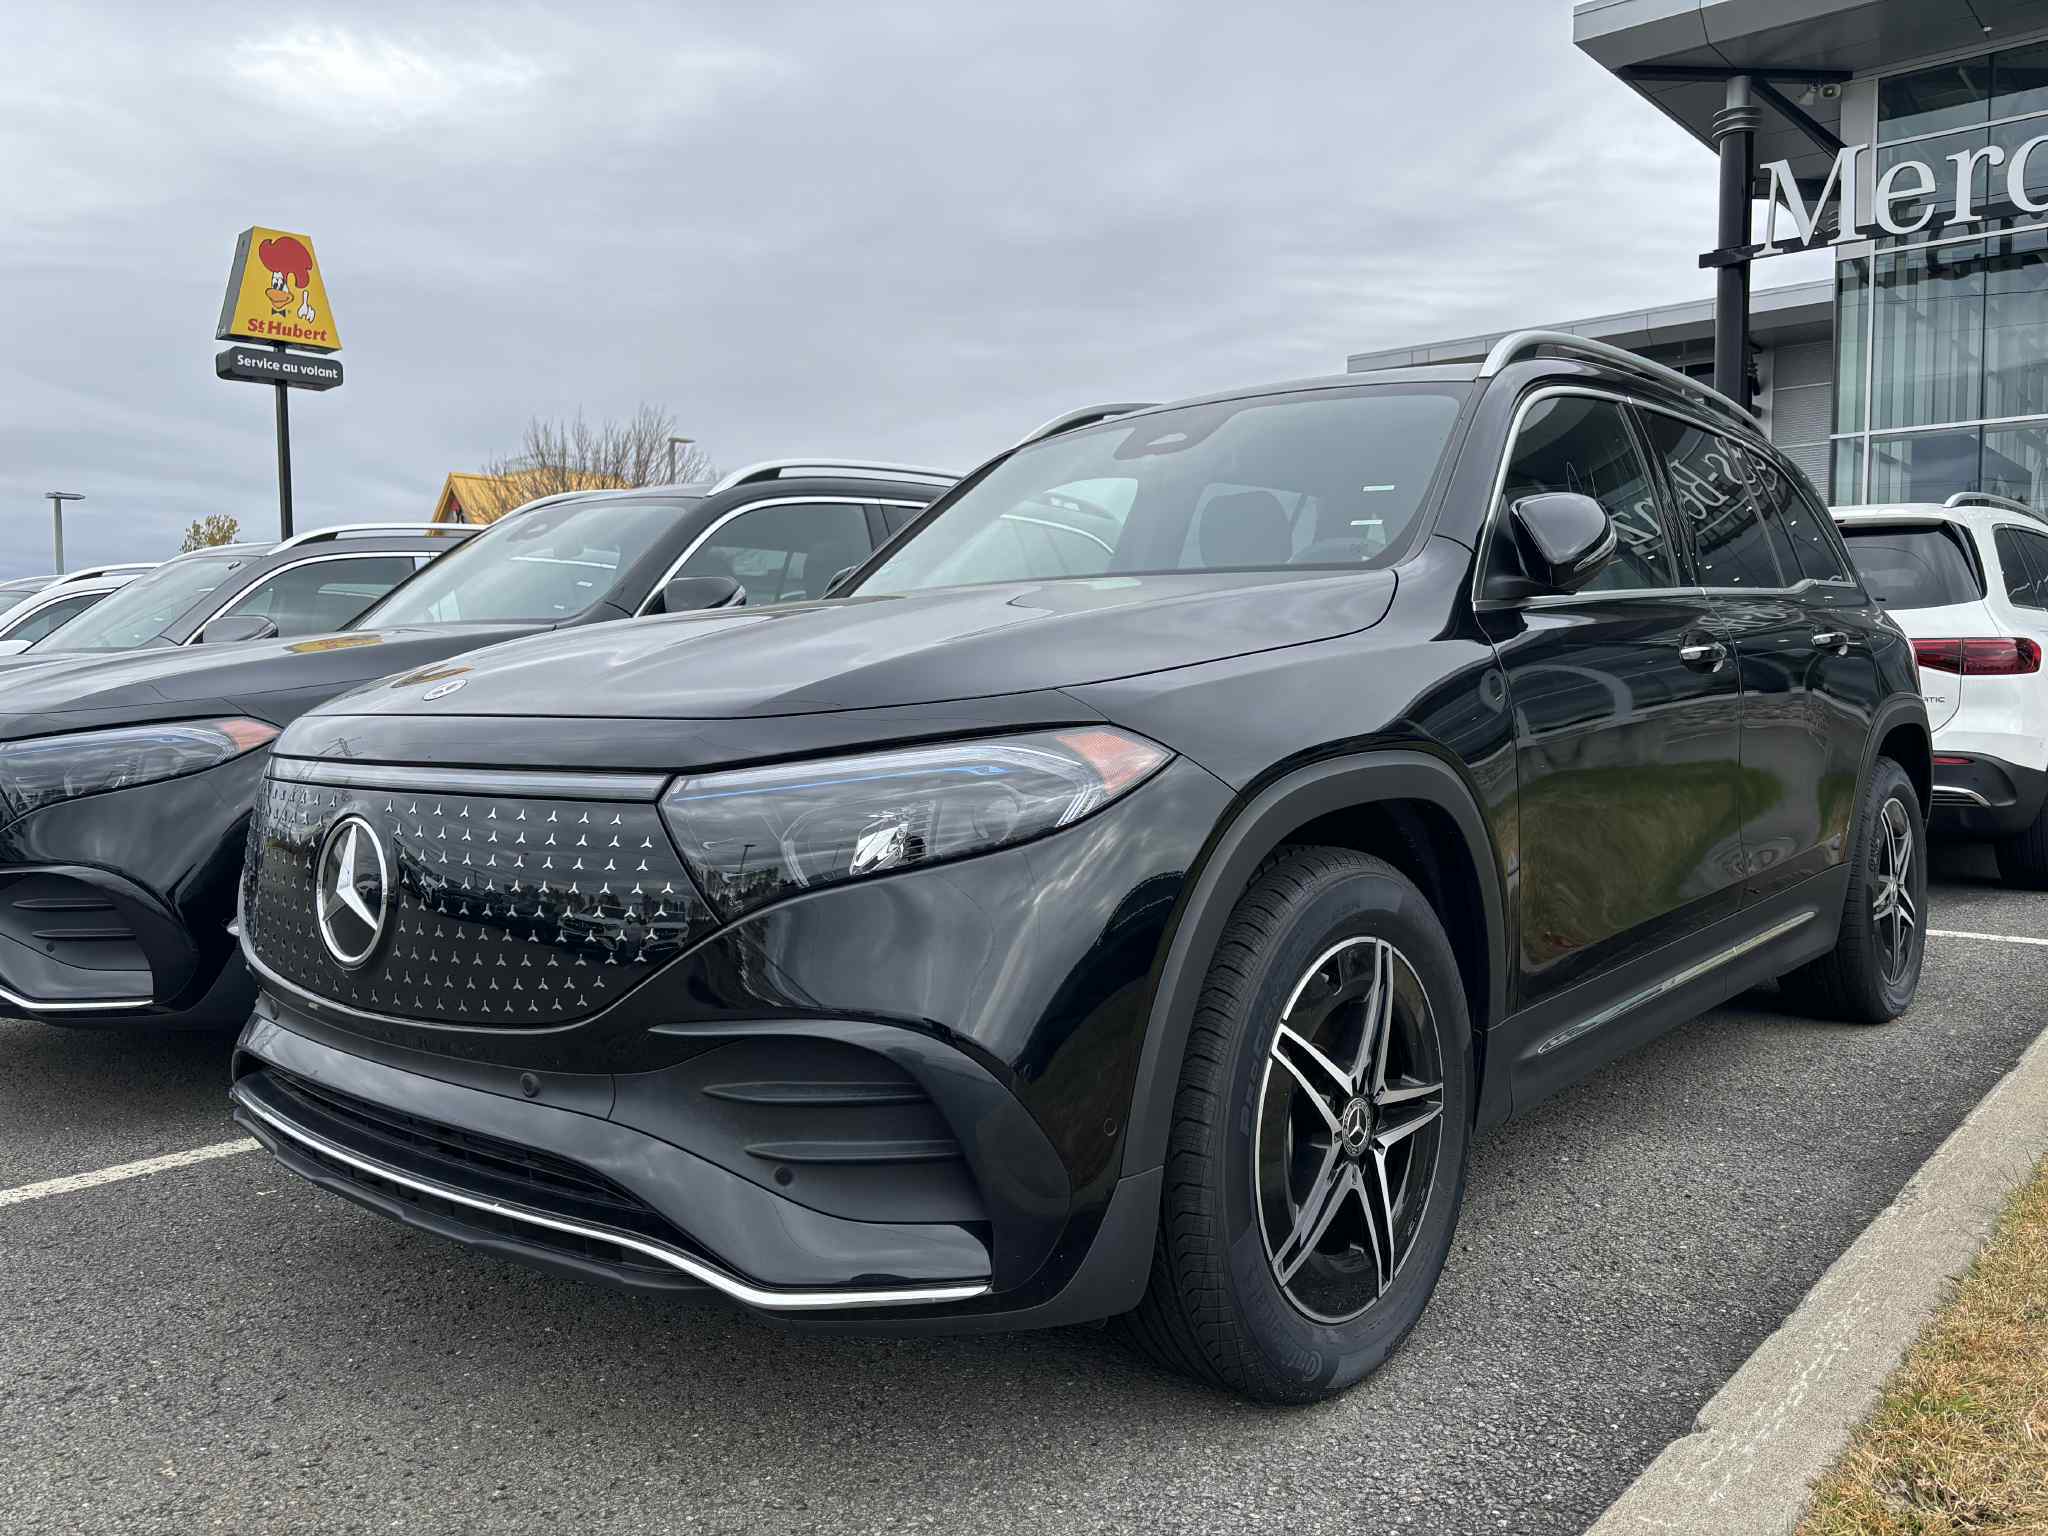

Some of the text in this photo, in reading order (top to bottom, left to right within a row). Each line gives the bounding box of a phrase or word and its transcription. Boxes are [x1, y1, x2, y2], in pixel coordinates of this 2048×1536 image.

[247, 318, 328, 341] St Hubert
[237, 355, 338, 378] Service au volant
